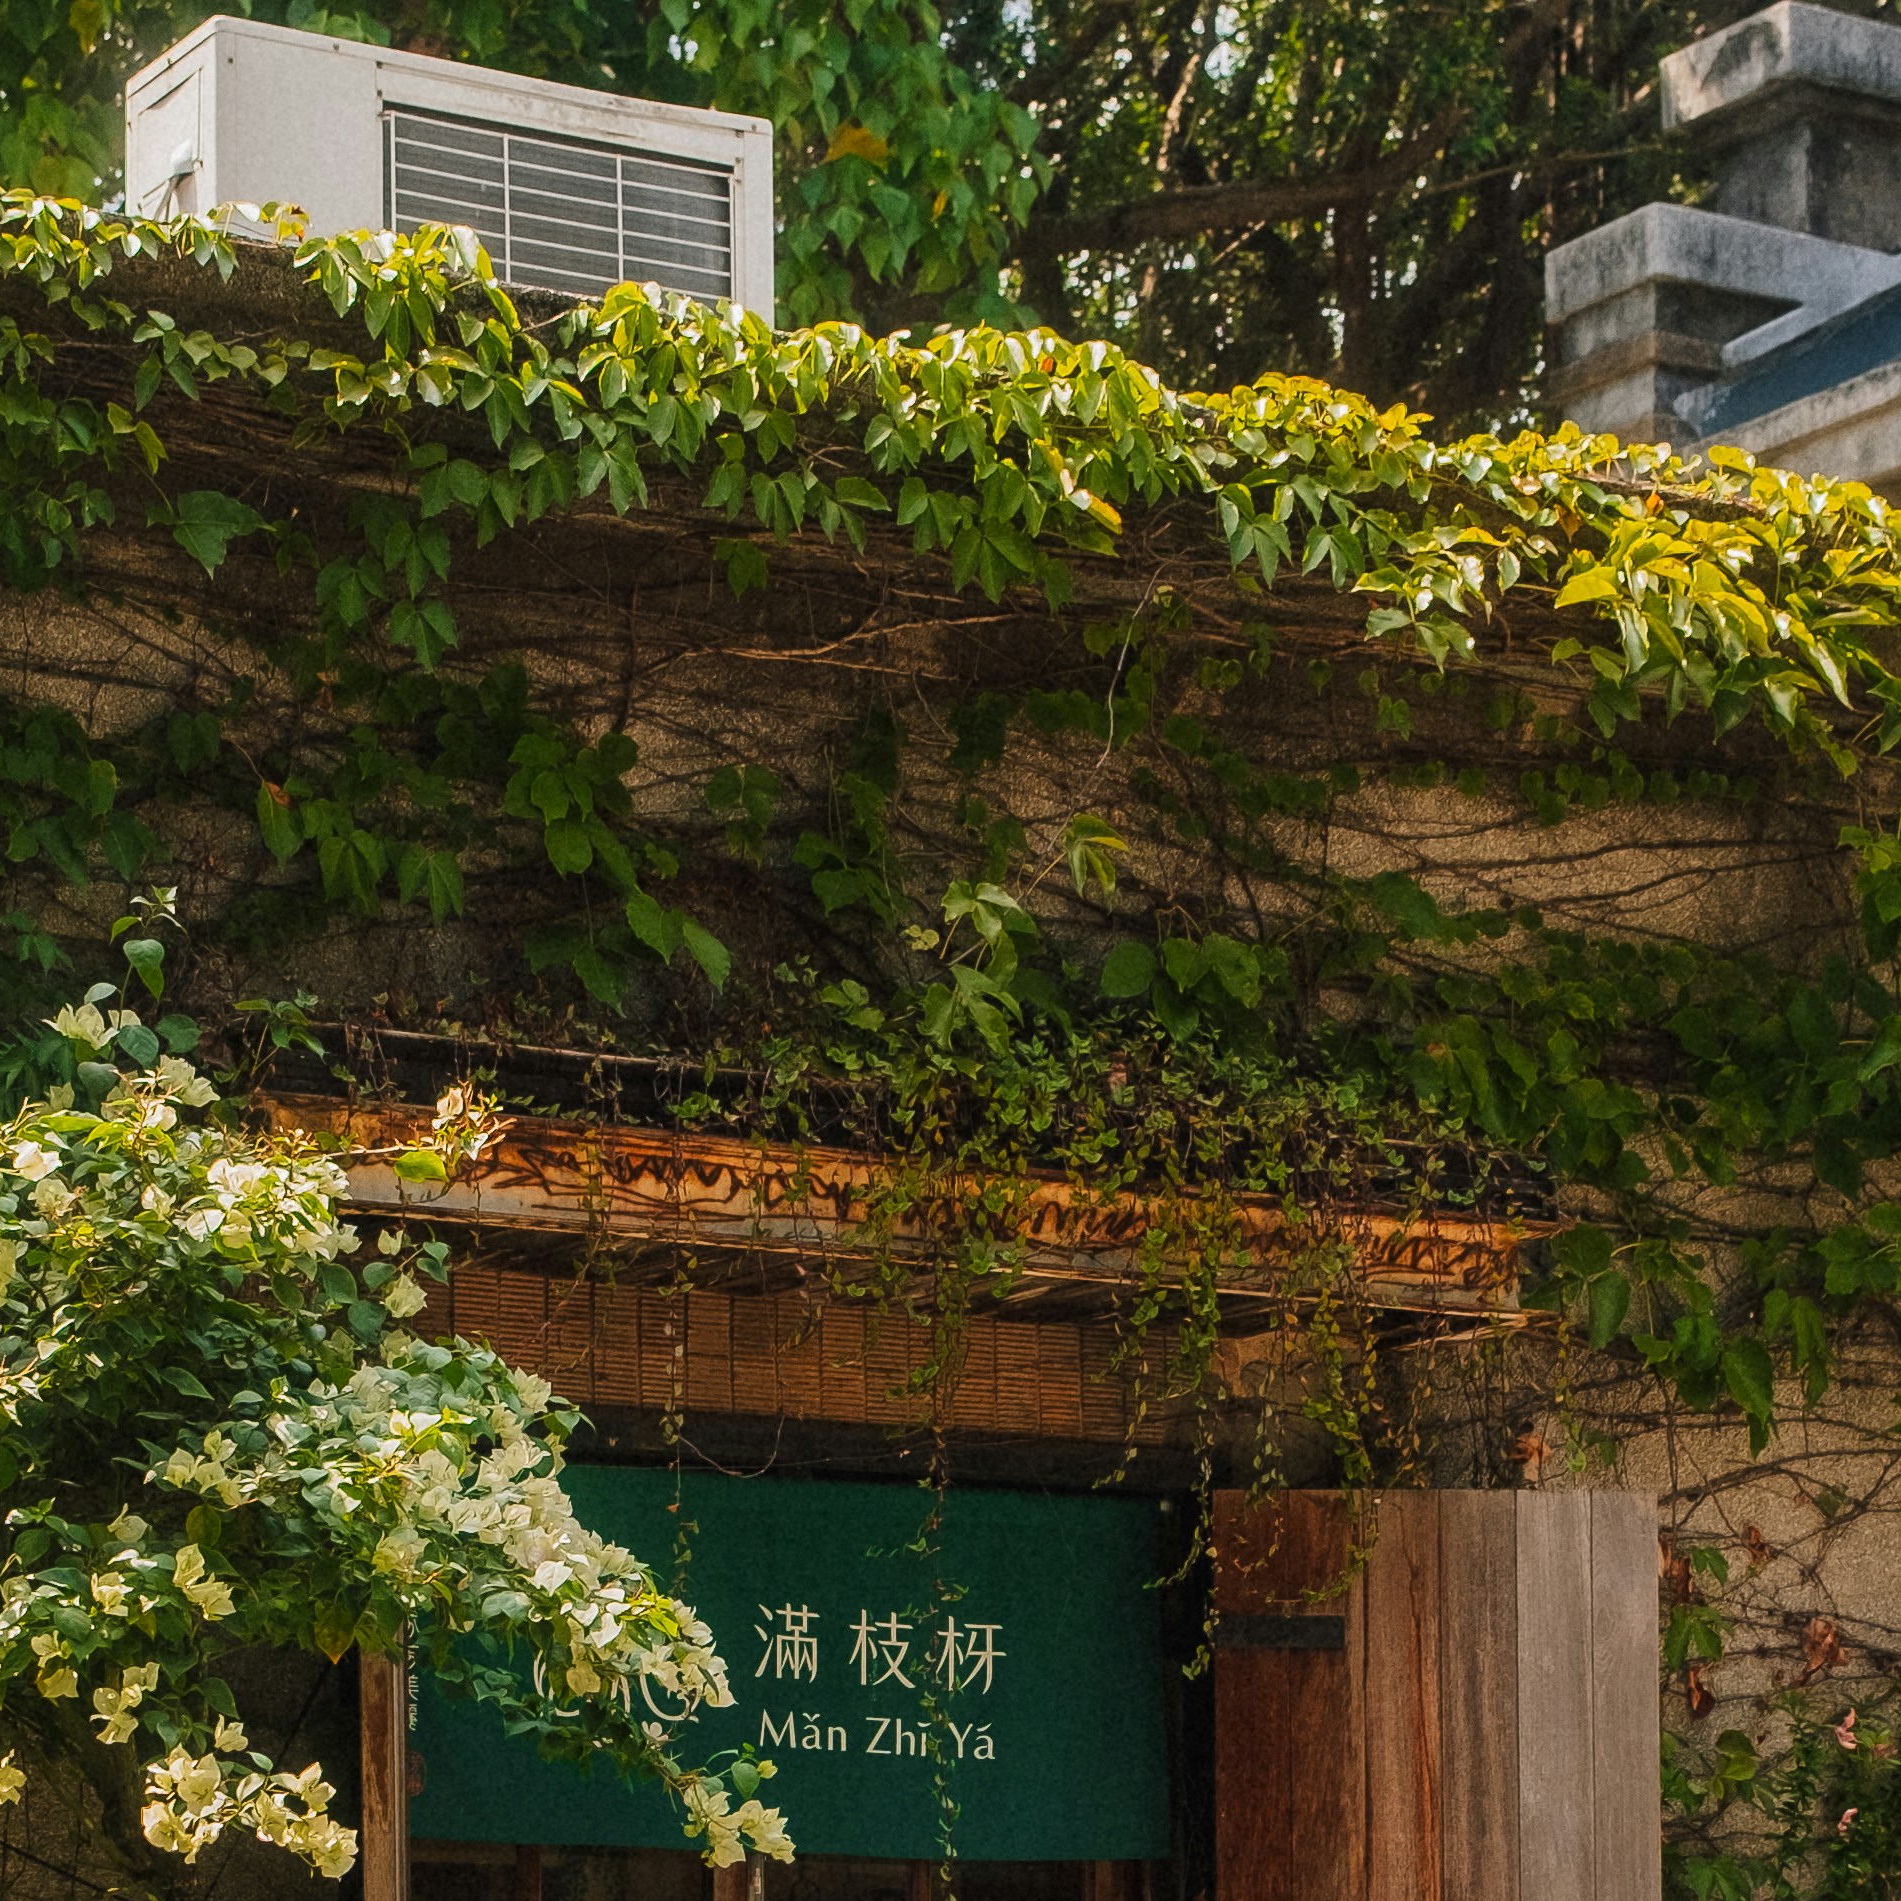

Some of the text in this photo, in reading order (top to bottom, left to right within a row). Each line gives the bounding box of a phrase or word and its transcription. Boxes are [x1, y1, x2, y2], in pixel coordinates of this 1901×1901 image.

[754, 1603, 1007, 1694] 滿枝枒
[949, 1722, 996, 1760] Yá
